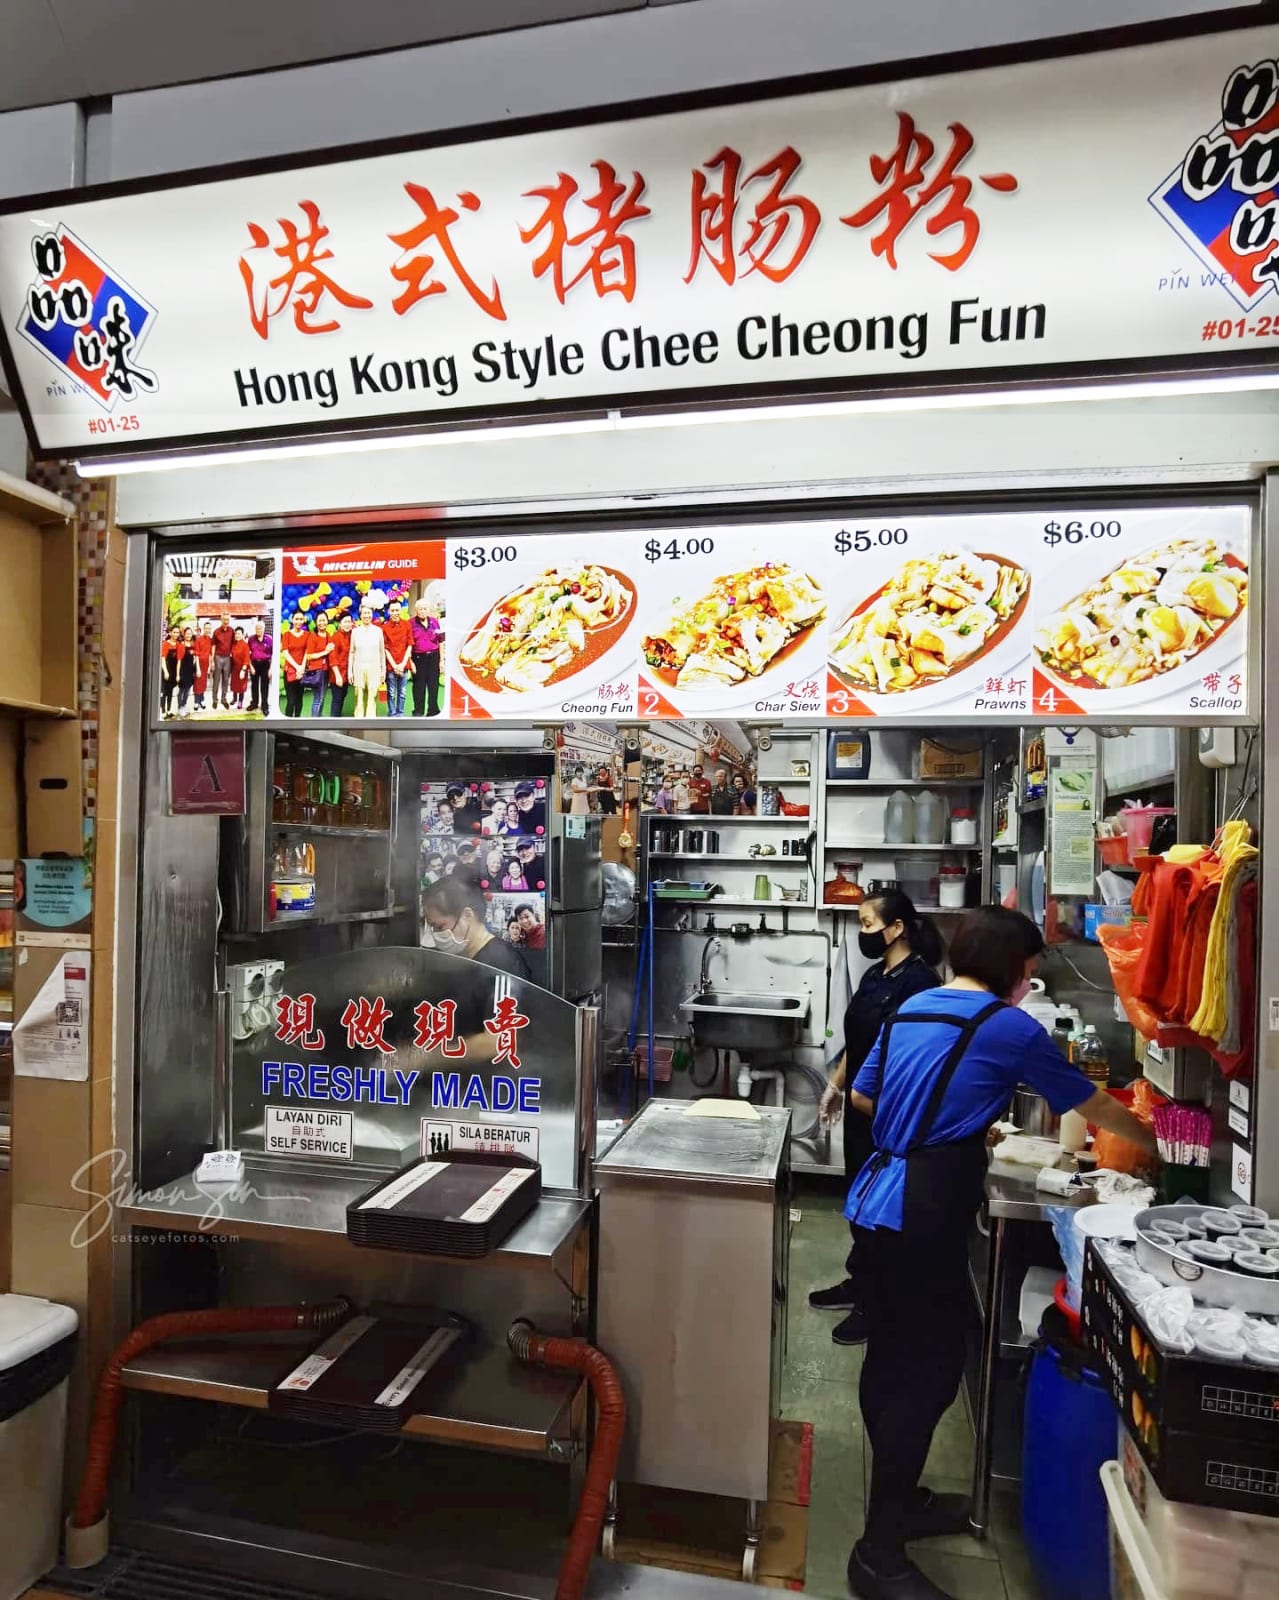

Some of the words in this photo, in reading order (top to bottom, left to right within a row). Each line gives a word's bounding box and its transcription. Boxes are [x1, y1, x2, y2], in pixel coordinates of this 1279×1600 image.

[238, 111, 1019, 341] 港式猪肠粉
[234, 368, 339, 408] Hong
[350, 352, 459, 397] Kong
[472, 334, 585, 389] Style
[601, 325, 719, 371] Chee
[737, 310, 929, 359] Cheong
[949, 296, 1047, 345] Fun
[88, 415, 140, 434] #01-25
[834, 527, 909, 555] $5.00
[1043, 520, 1122, 548] $6.00
[453, 545, 518, 570] $3.00
[644, 537, 715, 562] $4.00
[322, 560, 386, 571] MICHELIN
[387, 558, 418, 569] GUIDE
[460, 694, 473, 717] 1
[561, 702, 607, 715] Cheong
[610, 702, 633, 713] Fun
[644, 692, 660, 716] 2
[755, 701, 786, 712] Char
[789, 700, 821, 712] Siew
[832, 689, 850, 714] 3
[974, 698, 1027, 710] Prawns
[1039, 687, 1059, 712] 4
[1189, 696, 1243, 710] Scallop
[188, 753, 226, 794] A
[276, 994, 530, 1068] 現做現賣
[262, 1062, 418, 1106] FRESHLY
[431, 1073, 541, 1113] MADE
[276, 1110, 313, 1124] LAYAN
[317, 1114, 342, 1126] DIRI
[292, 1125, 326, 1138] 自助式
[459, 1126, 482, 1140] SILA
[483, 1128, 531, 1143] BERATUR
[270, 1136, 297, 1149] SELF
[300, 1138, 347, 1154] SERVICE
